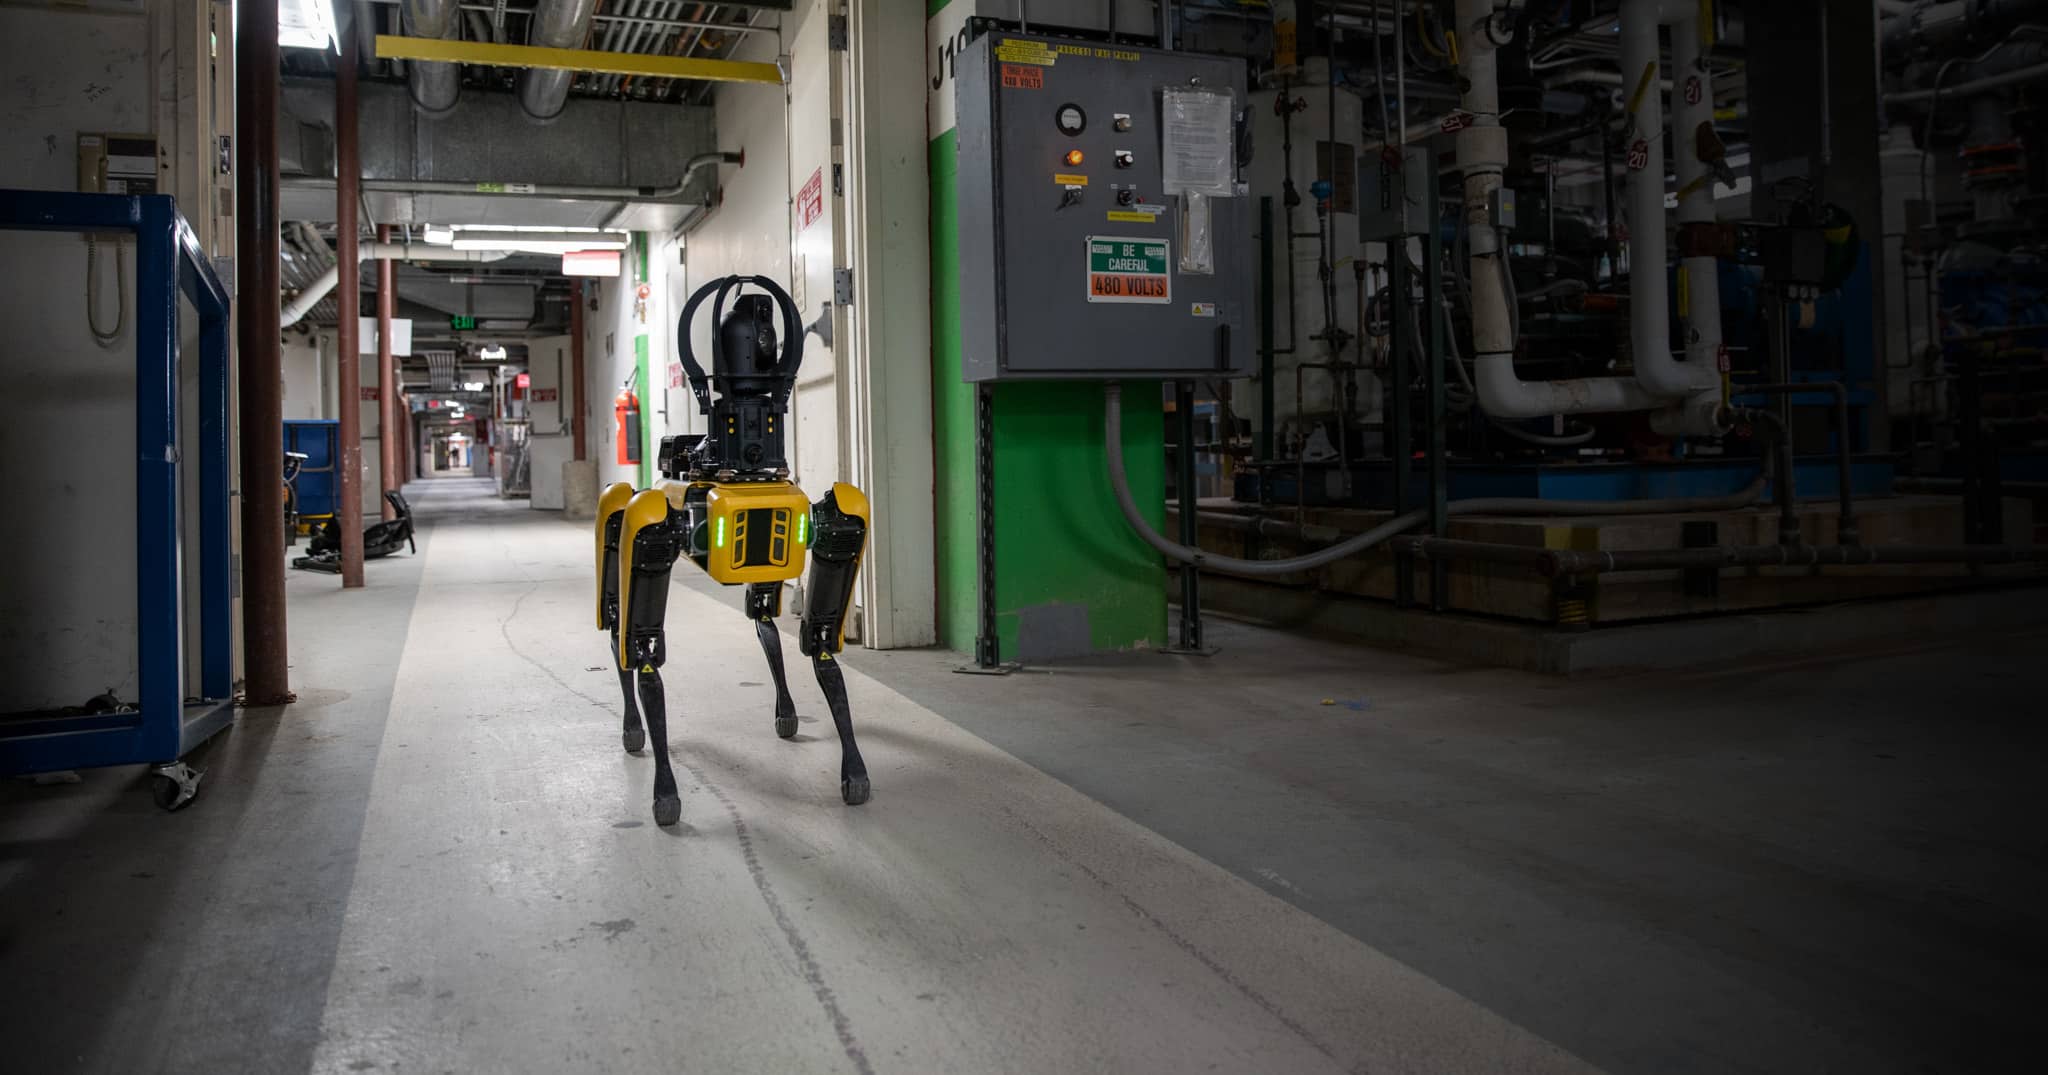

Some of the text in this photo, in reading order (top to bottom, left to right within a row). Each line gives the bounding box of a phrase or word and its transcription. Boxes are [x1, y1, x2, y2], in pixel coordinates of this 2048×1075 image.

[1020, 77, 1041, 88] VOLTS
[1629, 151, 1646, 168] 20
[1122, 243, 1135, 257] BE
[1108, 257, 1149, 272] CAREFUL
[1095, 276, 1164, 296] 480 VOLTS
[455, 315, 474, 328] EXIT
